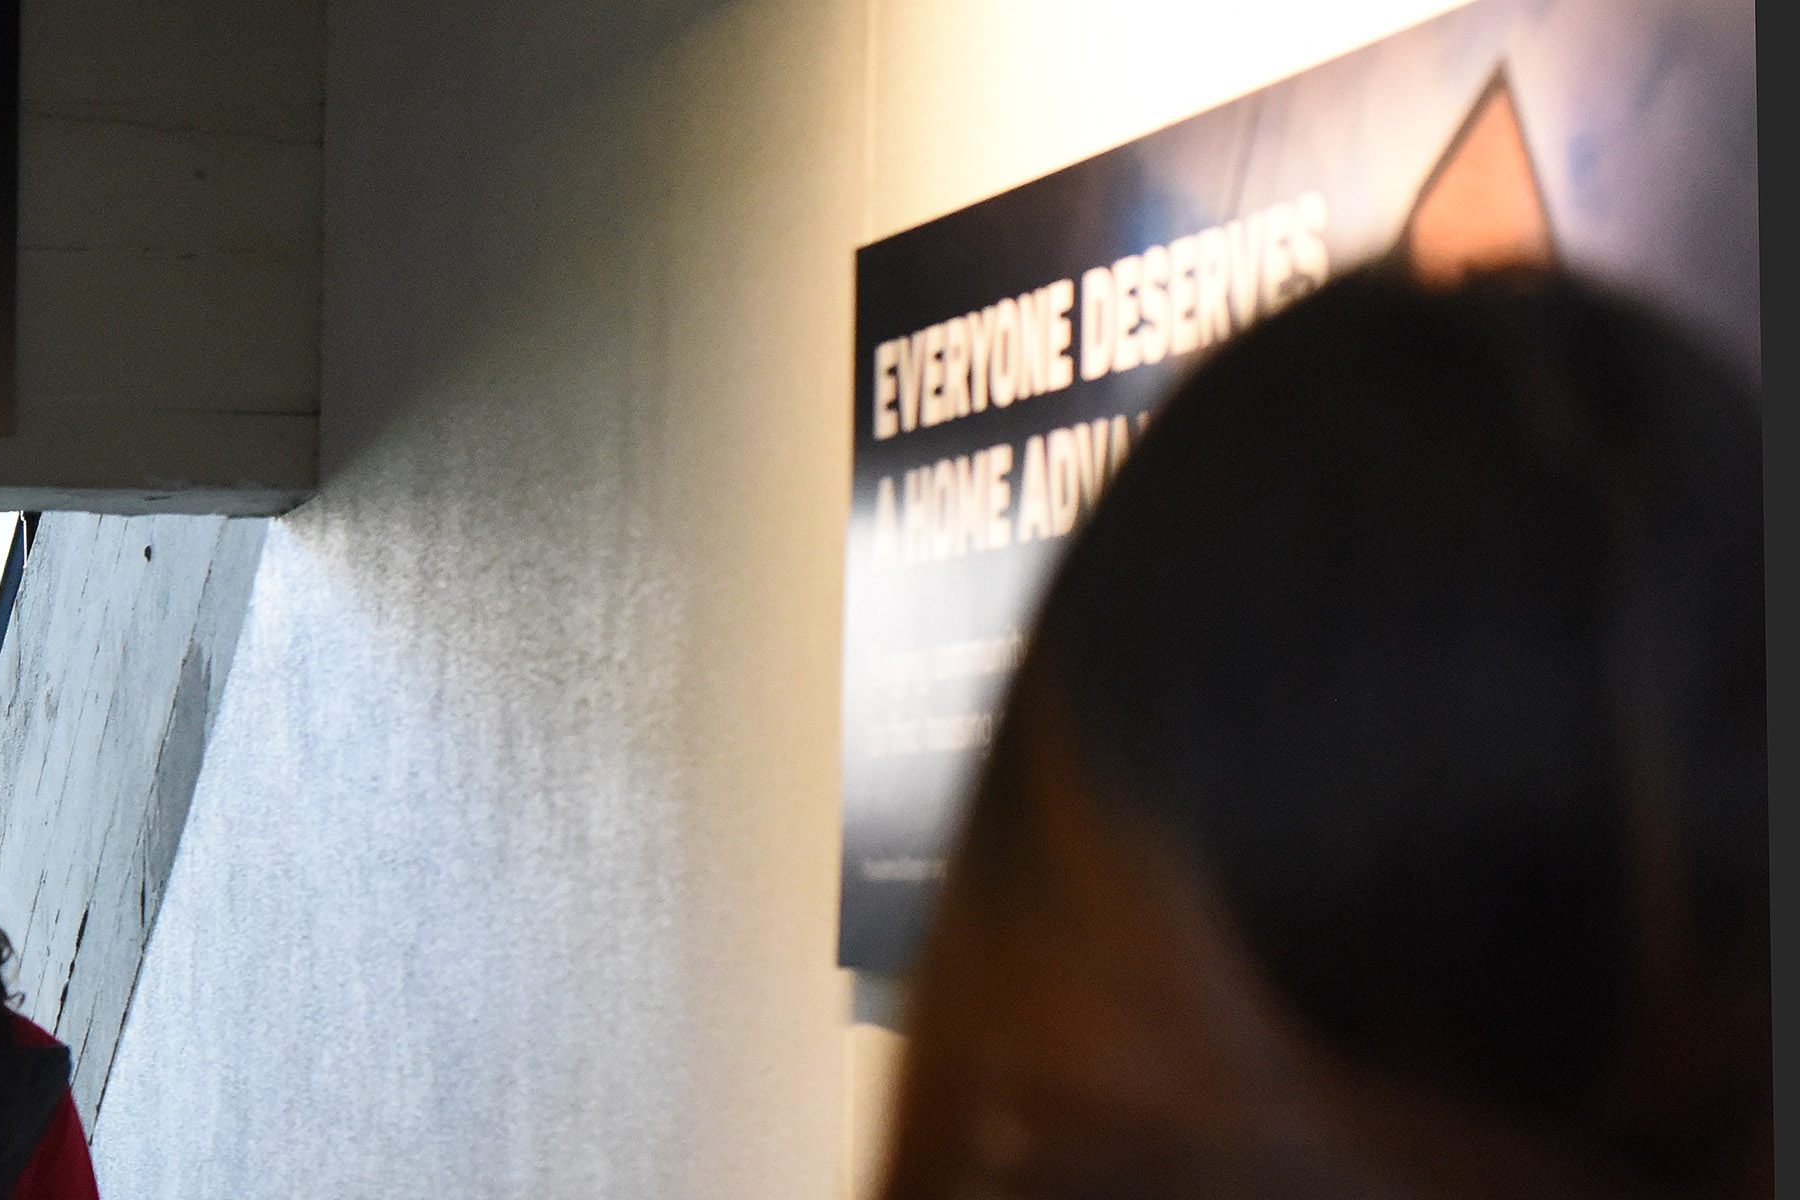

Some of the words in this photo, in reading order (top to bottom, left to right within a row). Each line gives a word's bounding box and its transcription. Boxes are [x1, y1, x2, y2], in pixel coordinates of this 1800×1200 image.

[873, 278, 1074, 441] EVERYONE
[871, 474, 901, 571] A
[903, 442, 1013, 564] HOME
